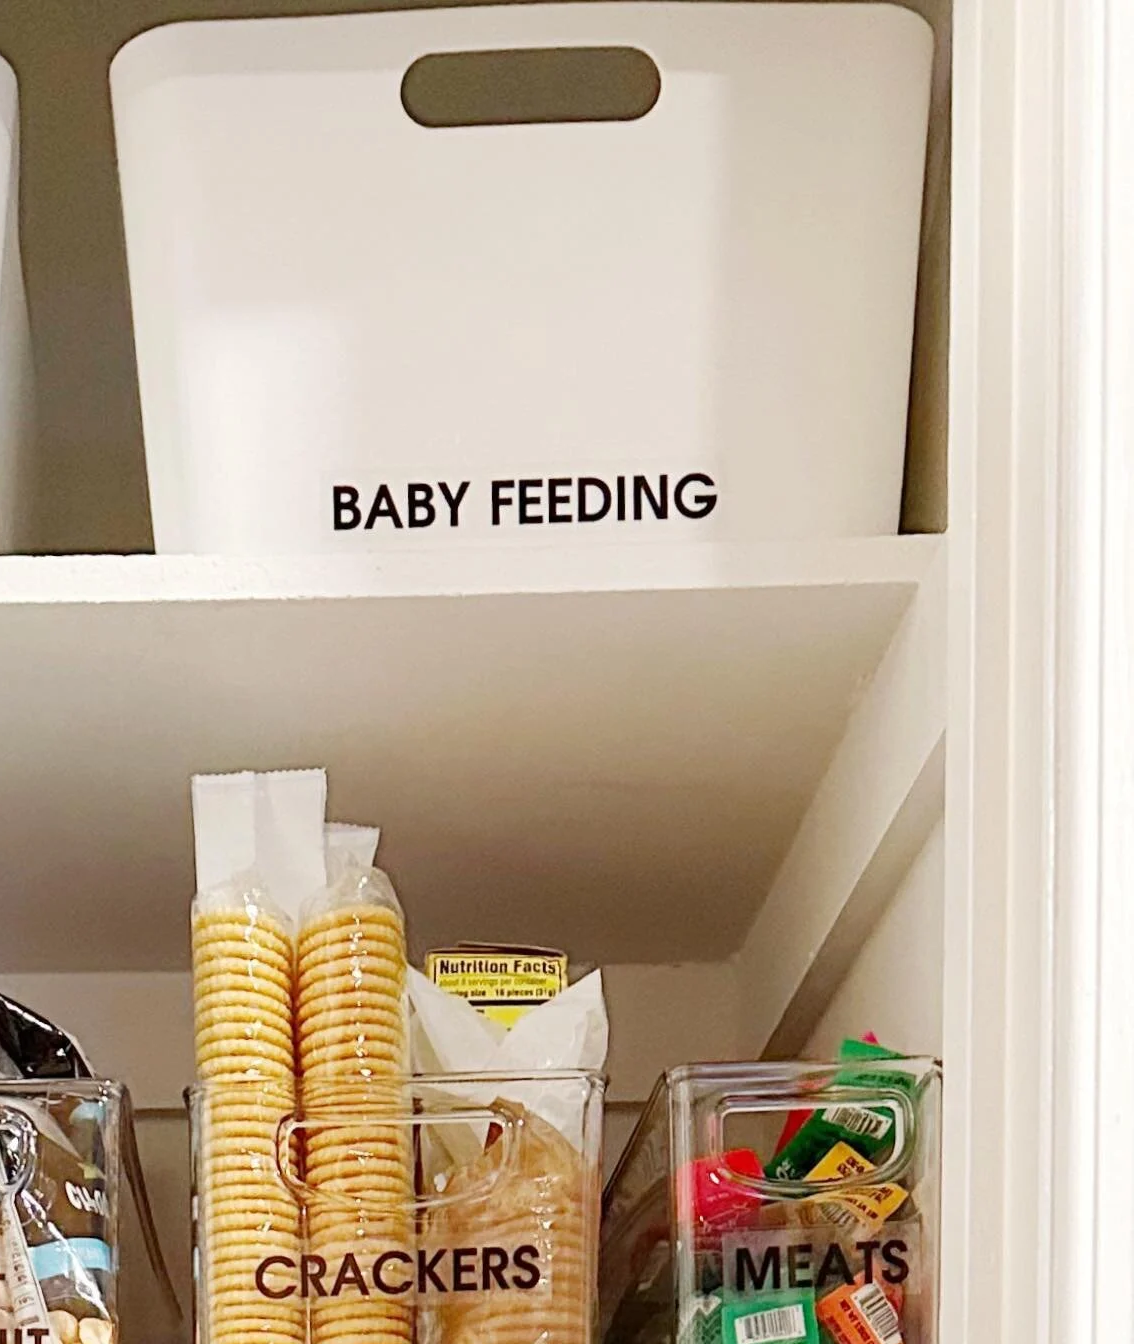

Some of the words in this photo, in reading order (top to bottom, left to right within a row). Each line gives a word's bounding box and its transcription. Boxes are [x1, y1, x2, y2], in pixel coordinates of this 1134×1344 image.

[332, 480, 471, 531] BABY
[491, 472, 718, 525] FEEDING
[439, 959, 508, 974] Nutrition
[513, 959, 556, 975] Facts
[254, 1244, 541, 1301] CRACKERS
[735, 1238, 910, 1292] MEATS
